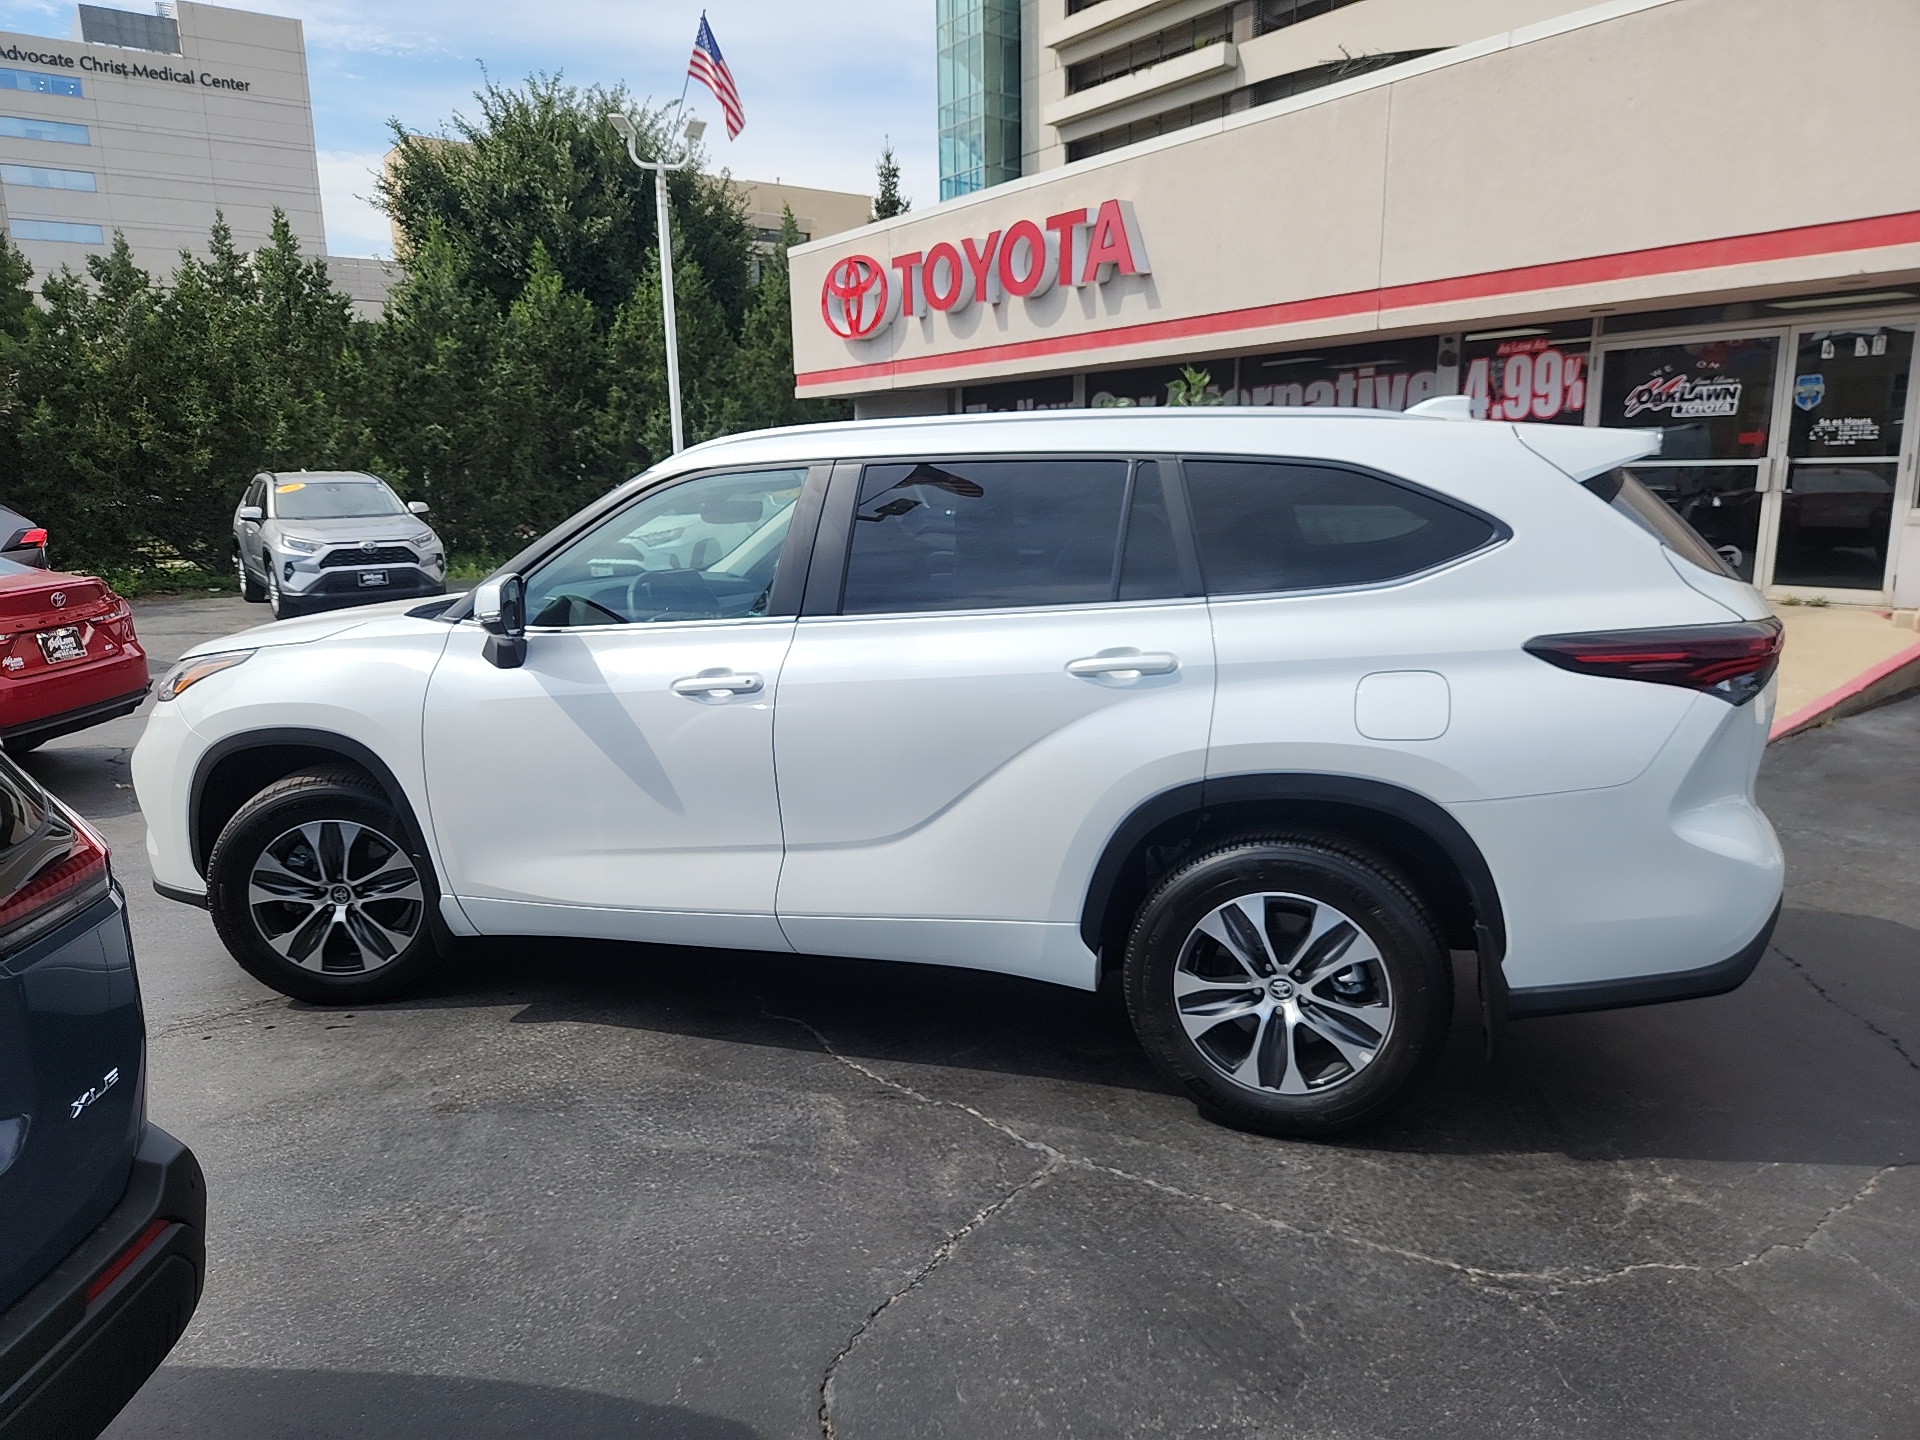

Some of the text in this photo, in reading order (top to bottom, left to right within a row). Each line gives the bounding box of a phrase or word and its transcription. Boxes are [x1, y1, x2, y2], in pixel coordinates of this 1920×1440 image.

[80, 55, 128, 76] Christ
[133, 63, 195, 84] Medical
[200, 72, 250, 92] Center
[892, 199, 1142, 318] TOYOTA
[1464, 350, 1585, 421] 4.99%
[70, 1067, 119, 1119] XLE
